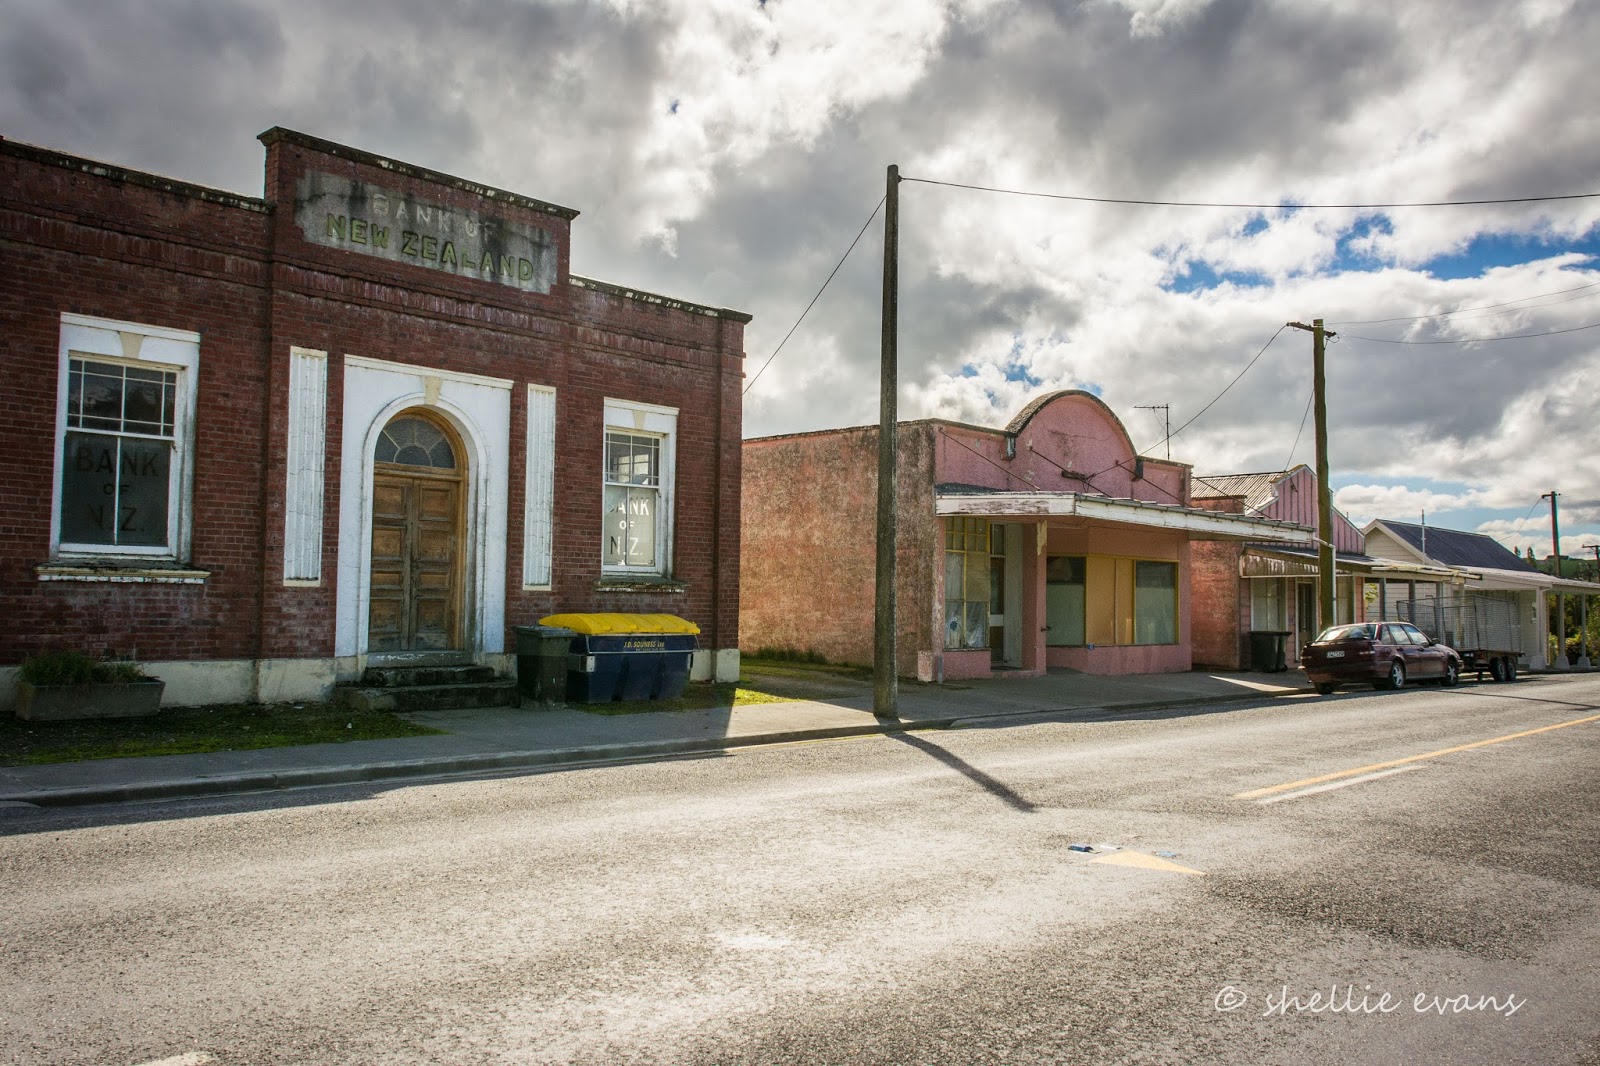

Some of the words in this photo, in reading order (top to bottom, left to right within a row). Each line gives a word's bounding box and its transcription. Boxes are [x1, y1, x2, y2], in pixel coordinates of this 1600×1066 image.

[373, 194, 450, 232] BANK
[465, 218, 497, 242] OF
[327, 212, 390, 248] NEW
[402, 230, 534, 281] ZEALAND
[76, 445, 159, 477] BANK
[103, 483, 131, 496] OF
[610, 497, 650, 515] ANK
[619, 520, 635, 530] OF
